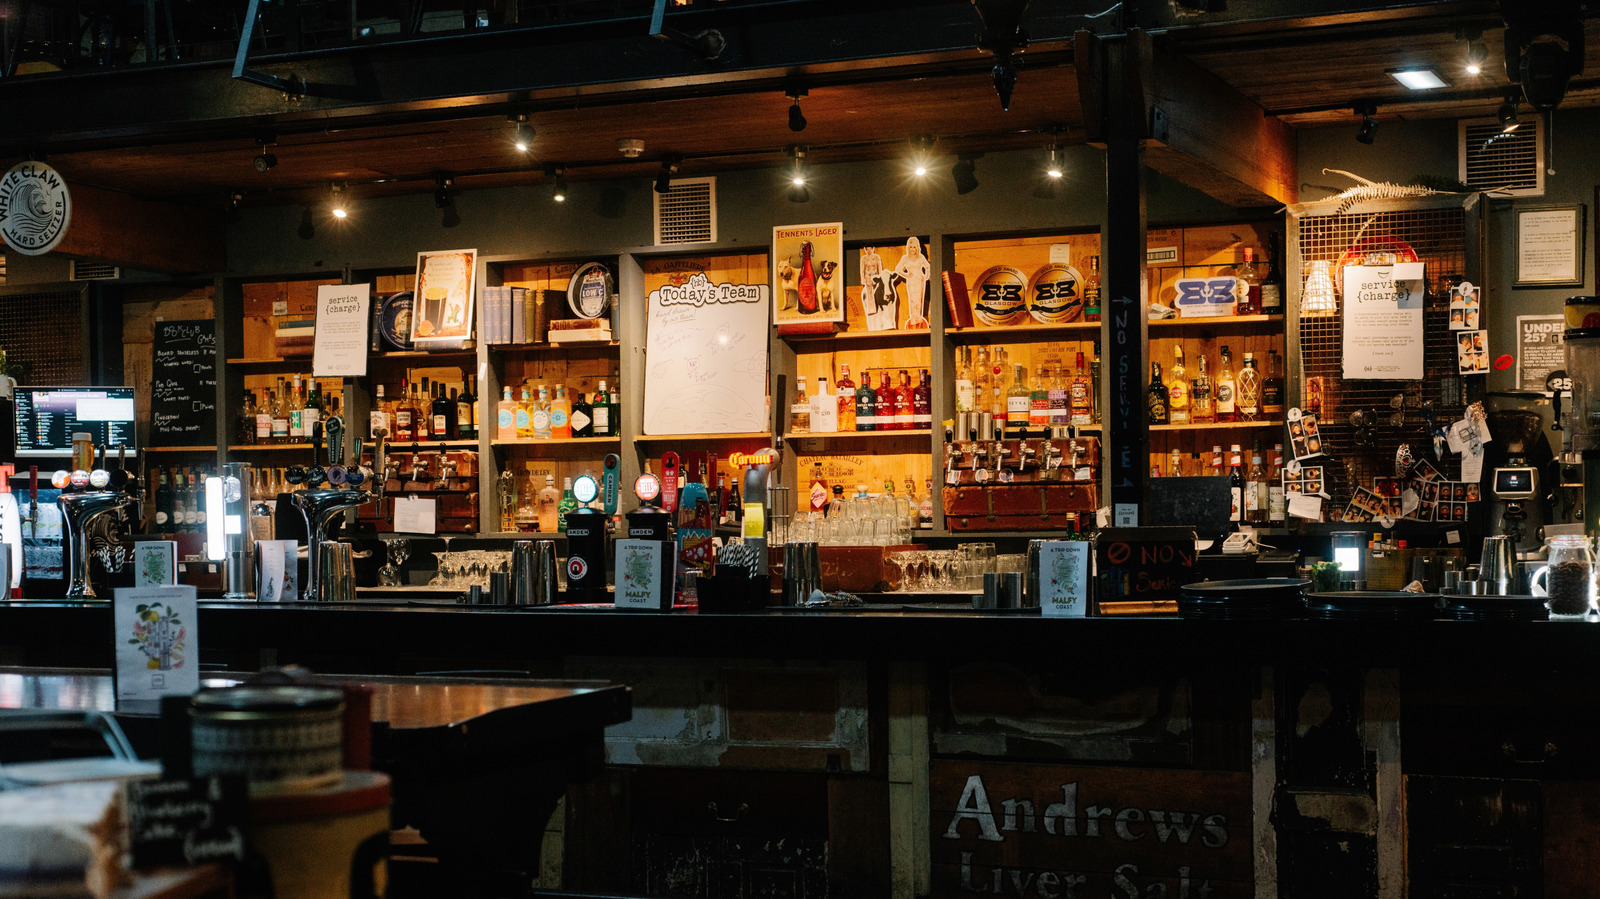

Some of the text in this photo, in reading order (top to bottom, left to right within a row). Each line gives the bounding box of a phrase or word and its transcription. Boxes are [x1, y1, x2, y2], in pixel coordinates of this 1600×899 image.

[0, 165, 60, 222] WHITE CLAW
[10, 201, 62, 245] HARD SELTZER
[776, 227, 838, 239] TENNENT'S LAGER
[1003, 267, 1019, 275] AWARD
[1361, 280, 1406, 290] service
[582, 287, 604, 298] LOW C
[662, 286, 757, 303] Today's Team
[1356, 288, 1411, 303] {charge}
[328, 295, 359, 305] service
[1039, 297, 1073, 306] GLASGOW
[299, 303, 315, 313] Camp
[325, 302, 361, 315] {charge}
[1523, 333, 1547, 343] 25?
[1115, 310, 1132, 468] NO SERVIE
[1553, 377, 1573, 390] 25
[729, 451, 774, 469] Corona
[799, 455, 828, 467] CHATEAU
[1140, 544, 1174, 565] NO
[942, 774, 1230, 848] Andrews
[960, 851, 1215, 899] Liver Salt
